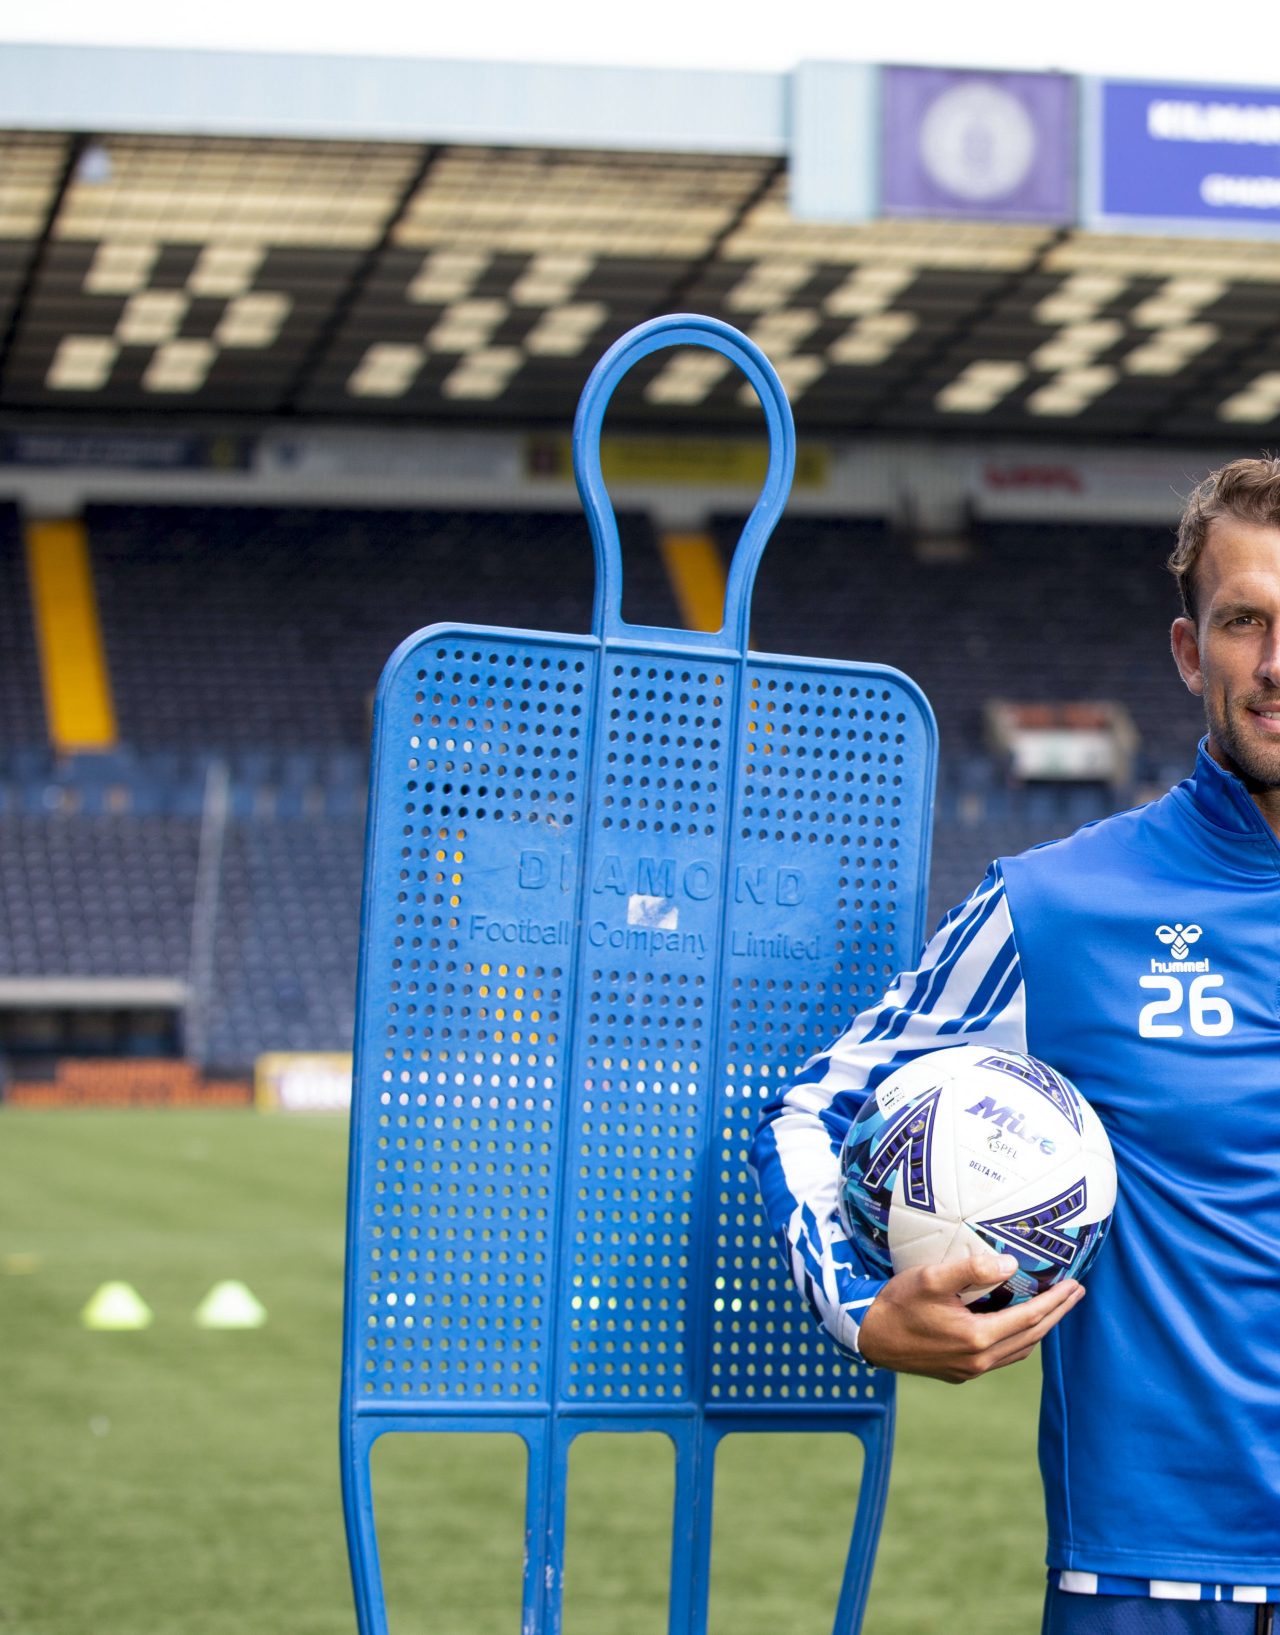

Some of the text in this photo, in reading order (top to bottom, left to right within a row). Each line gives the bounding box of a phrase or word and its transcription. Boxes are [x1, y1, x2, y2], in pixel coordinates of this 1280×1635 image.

[518, 850, 806, 907] DIAMOND
[469, 913, 820, 960] Football Company Limited
[1151, 958, 1209, 973] hummel
[1138, 974, 1234, 1037] 26
[964, 1096, 1057, 1155] Mie
[969, 1159, 991, 1176] DELTA
[993, 1140, 1017, 1159] SPFL
